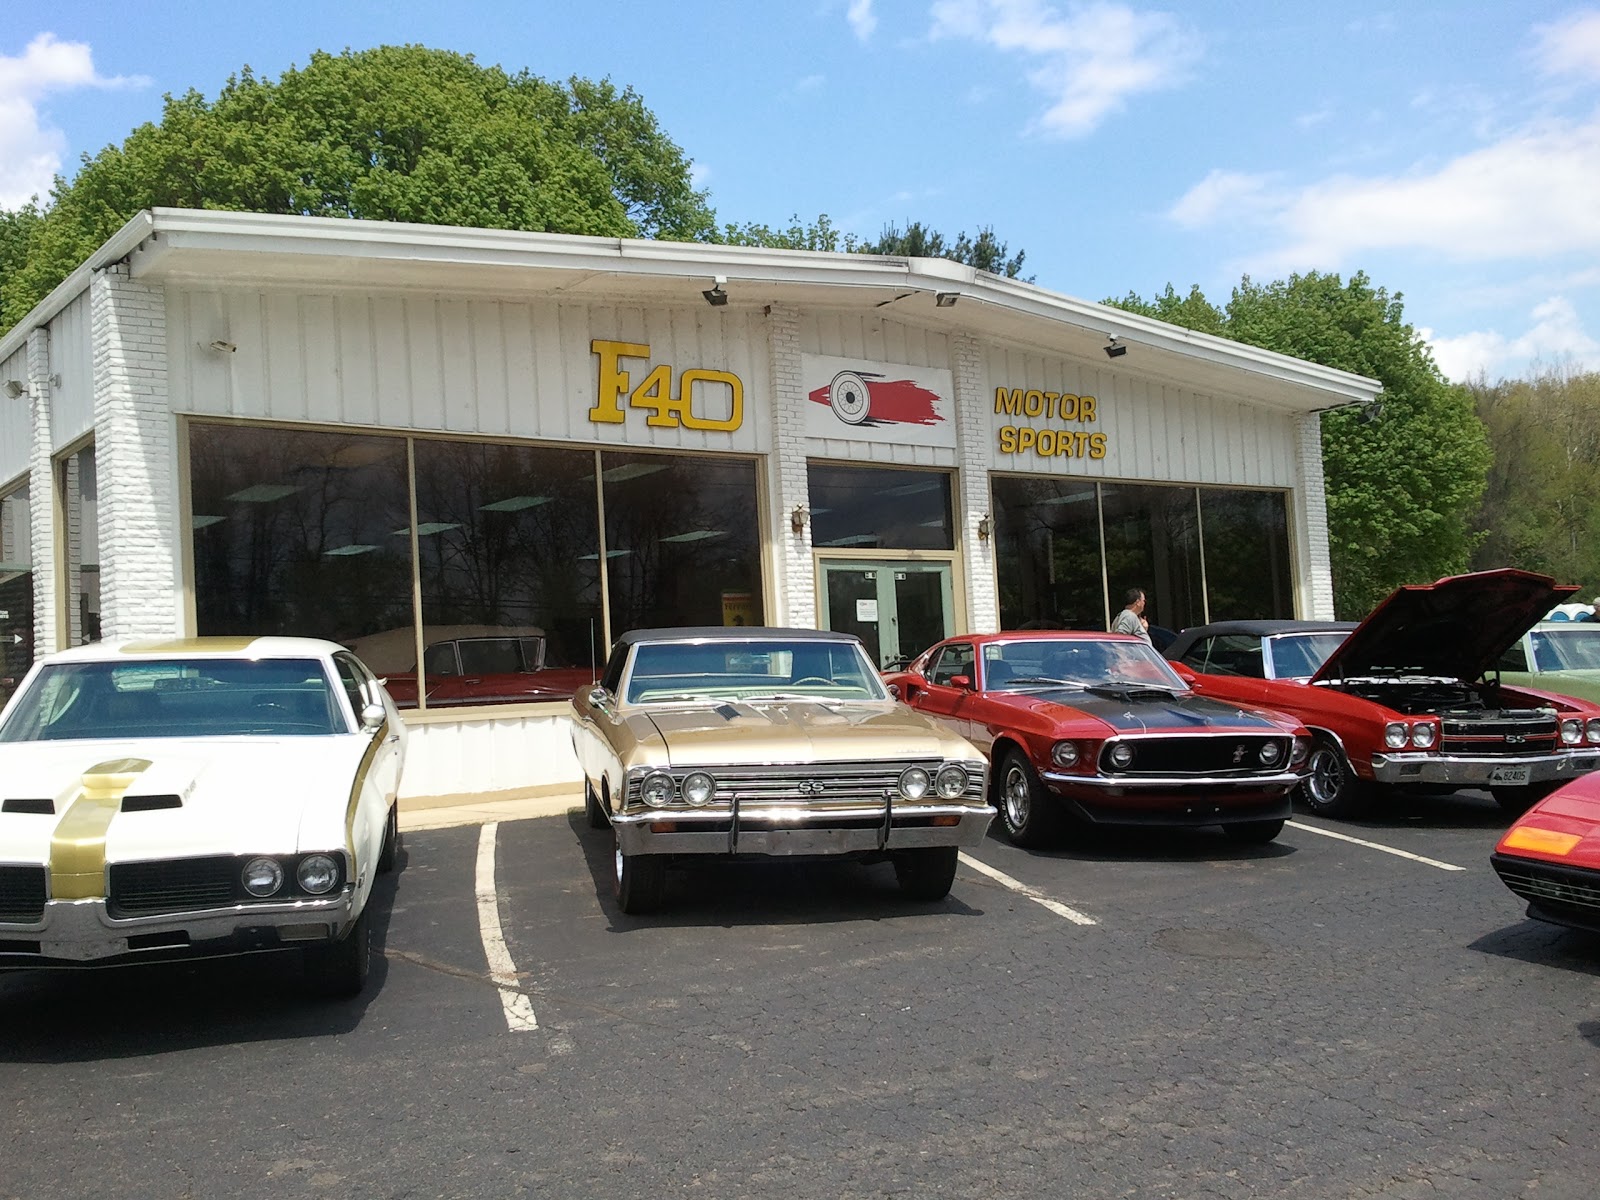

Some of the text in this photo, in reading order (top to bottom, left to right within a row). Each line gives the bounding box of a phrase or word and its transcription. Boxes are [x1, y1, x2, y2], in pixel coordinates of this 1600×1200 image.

[589, 339, 744, 432] F40
[994, 387, 1096, 422] MOTOR
[999, 425, 1107, 460] SPORTS
[1505, 734, 1526, 744] SS
[799, 782, 825, 792] SS
